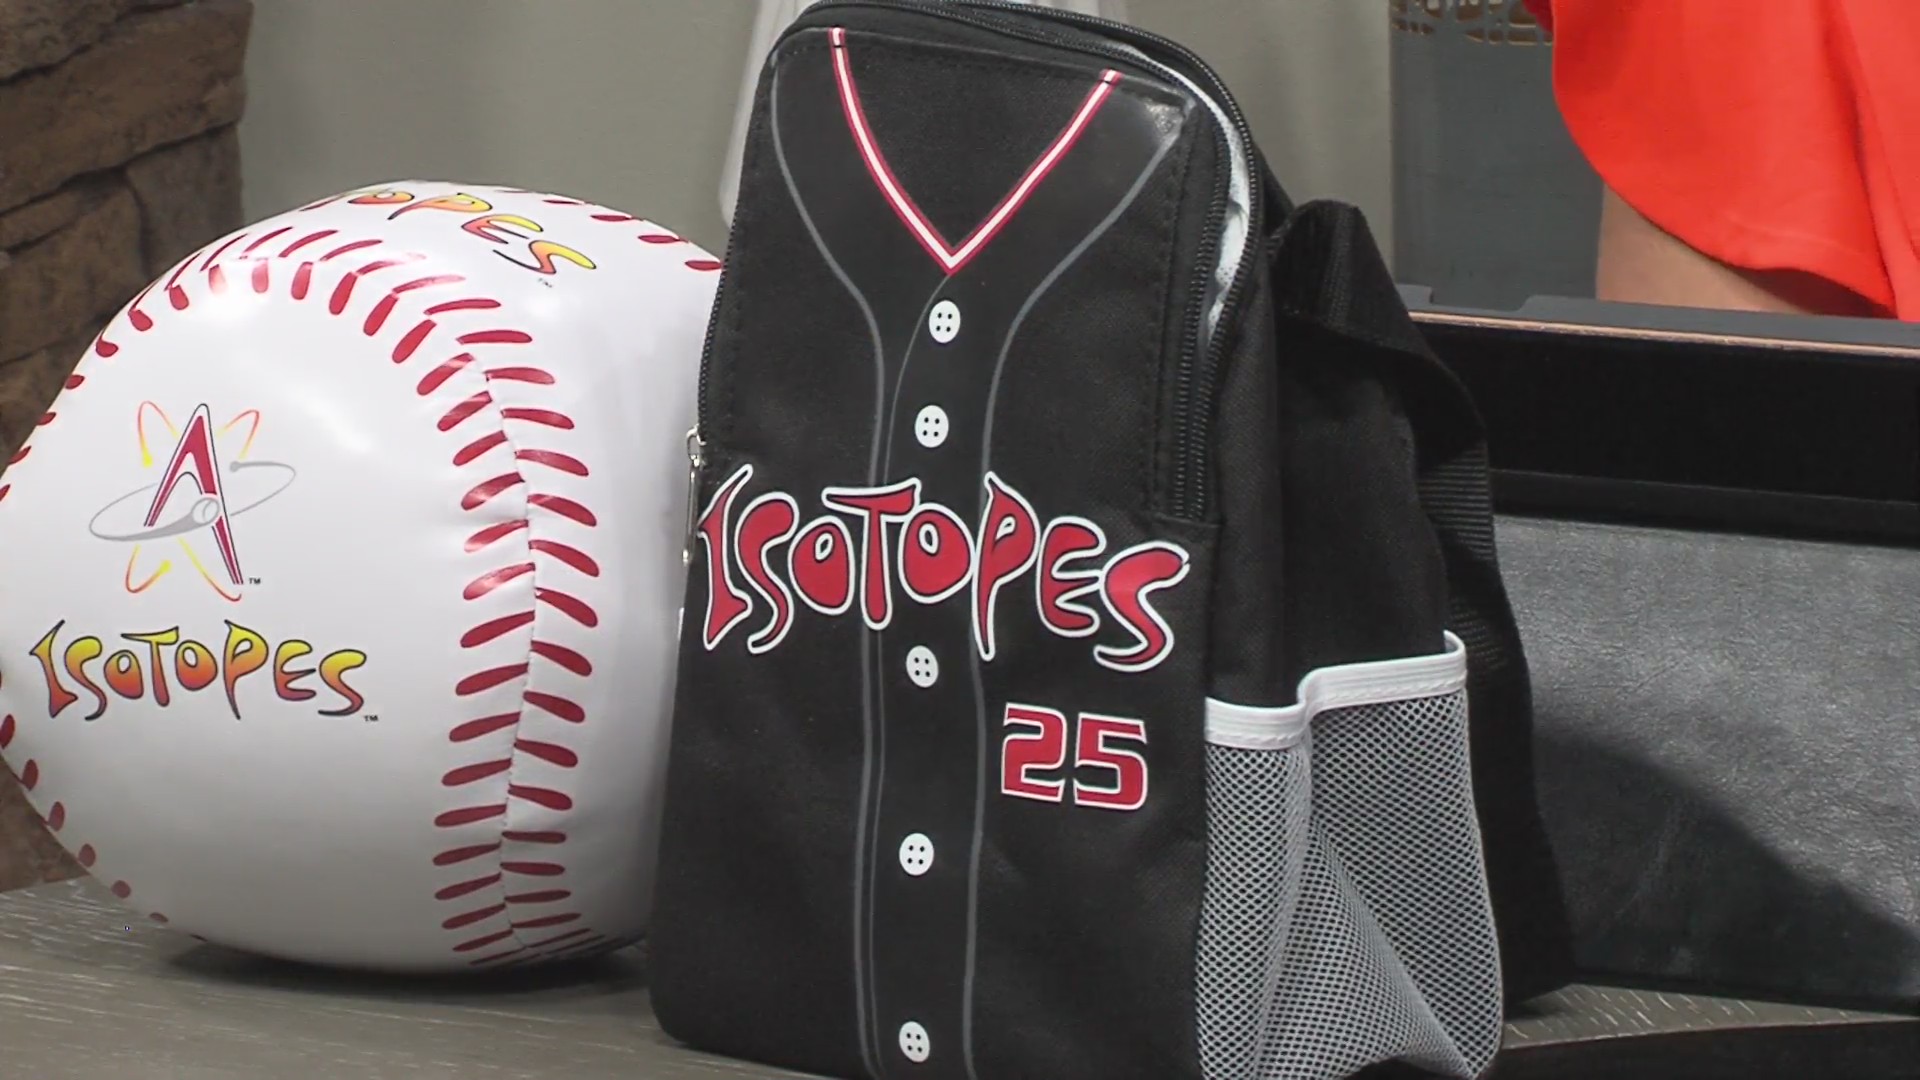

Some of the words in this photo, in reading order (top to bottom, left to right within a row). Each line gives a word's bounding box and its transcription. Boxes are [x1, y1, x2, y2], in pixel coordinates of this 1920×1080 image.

[698, 464, 1190, 672] ISOTOPES
[29, 619, 367, 721] ISOTOPES
[1001, 702, 1148, 811] 25
